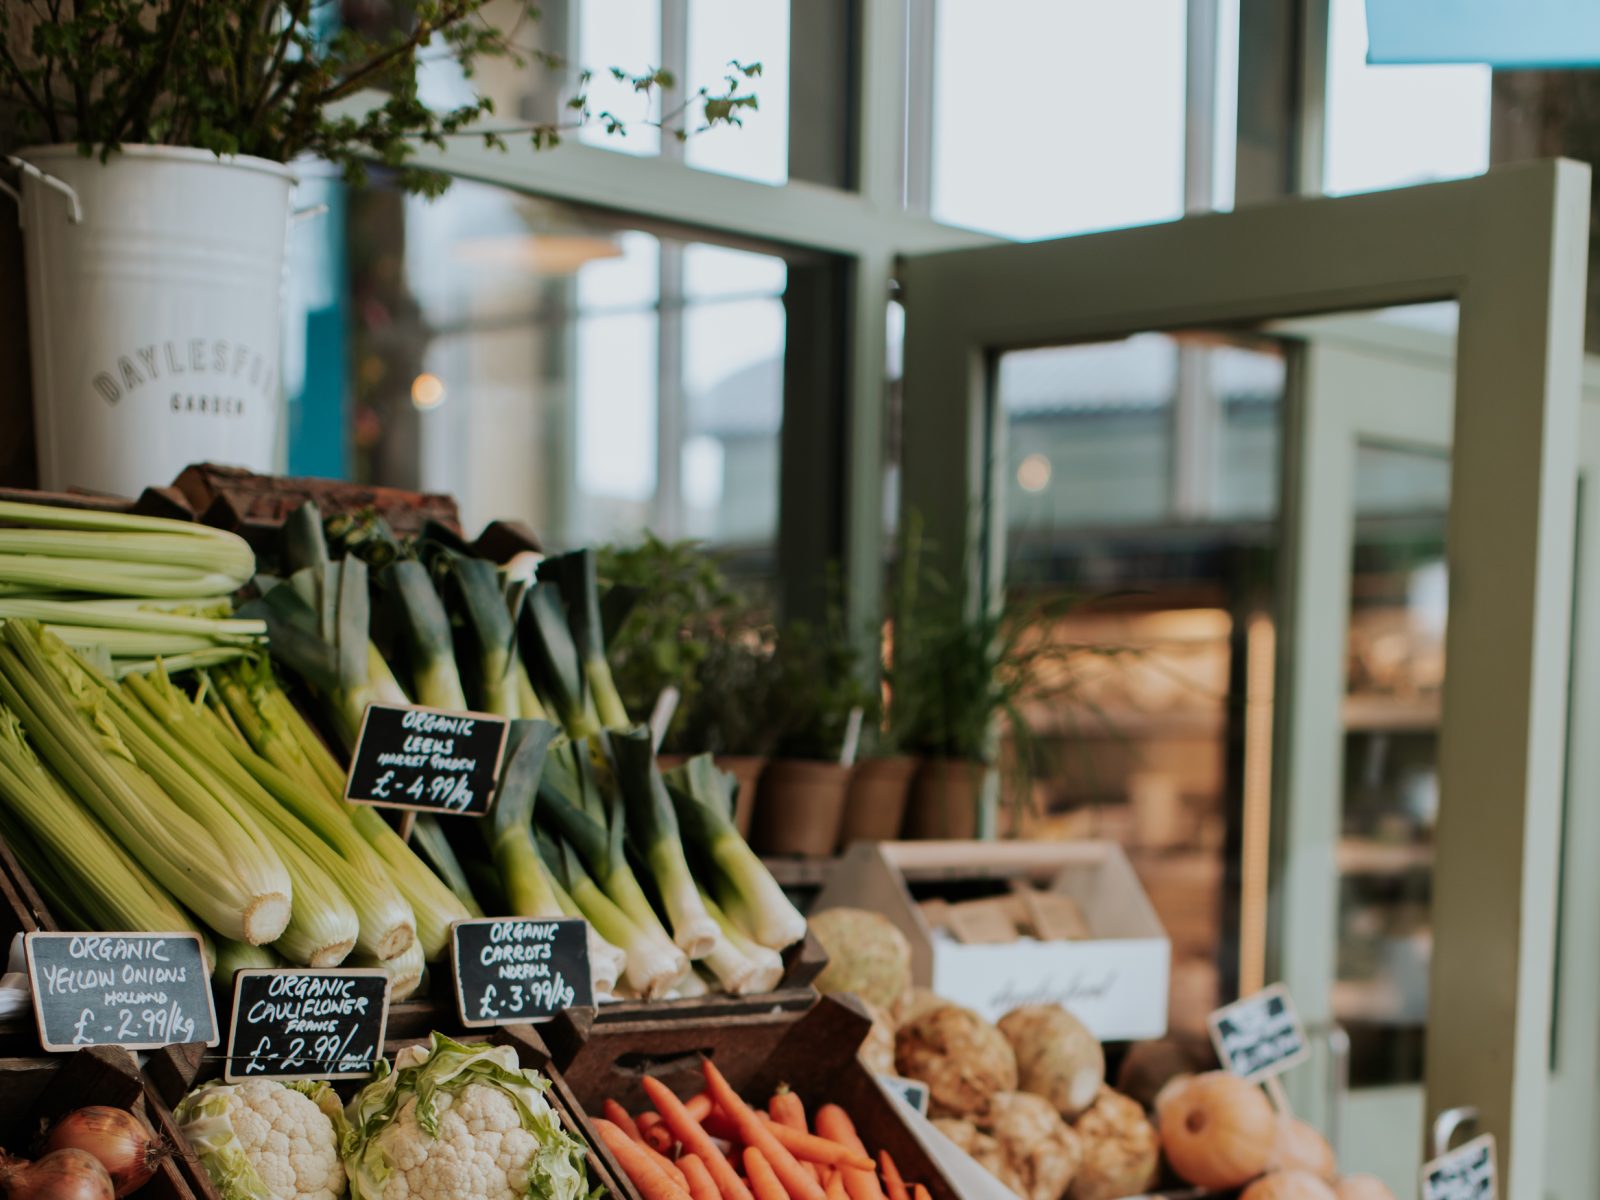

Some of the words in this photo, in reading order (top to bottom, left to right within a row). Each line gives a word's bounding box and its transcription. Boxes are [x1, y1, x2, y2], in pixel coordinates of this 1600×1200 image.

[401, 710, 475, 737] ORGANIC
[403, 735, 454, 755] LEEKS
[490, 921, 559, 943] ORGANIC
[69, 936, 171, 962] ORGANIC
[480, 943, 552, 966] CARROTS
[43, 964, 115, 995] YELLOW
[121, 964, 186, 985] ONIONS
[499, 963, 551, 980] NORFOLK
[268, 974, 356, 999] ORGANIC
[104, 990, 168, 1007] HOLLAND
[247, 997, 369, 1024] CAULIFLOWER
[284, 1019, 339, 1034] FRANCE
